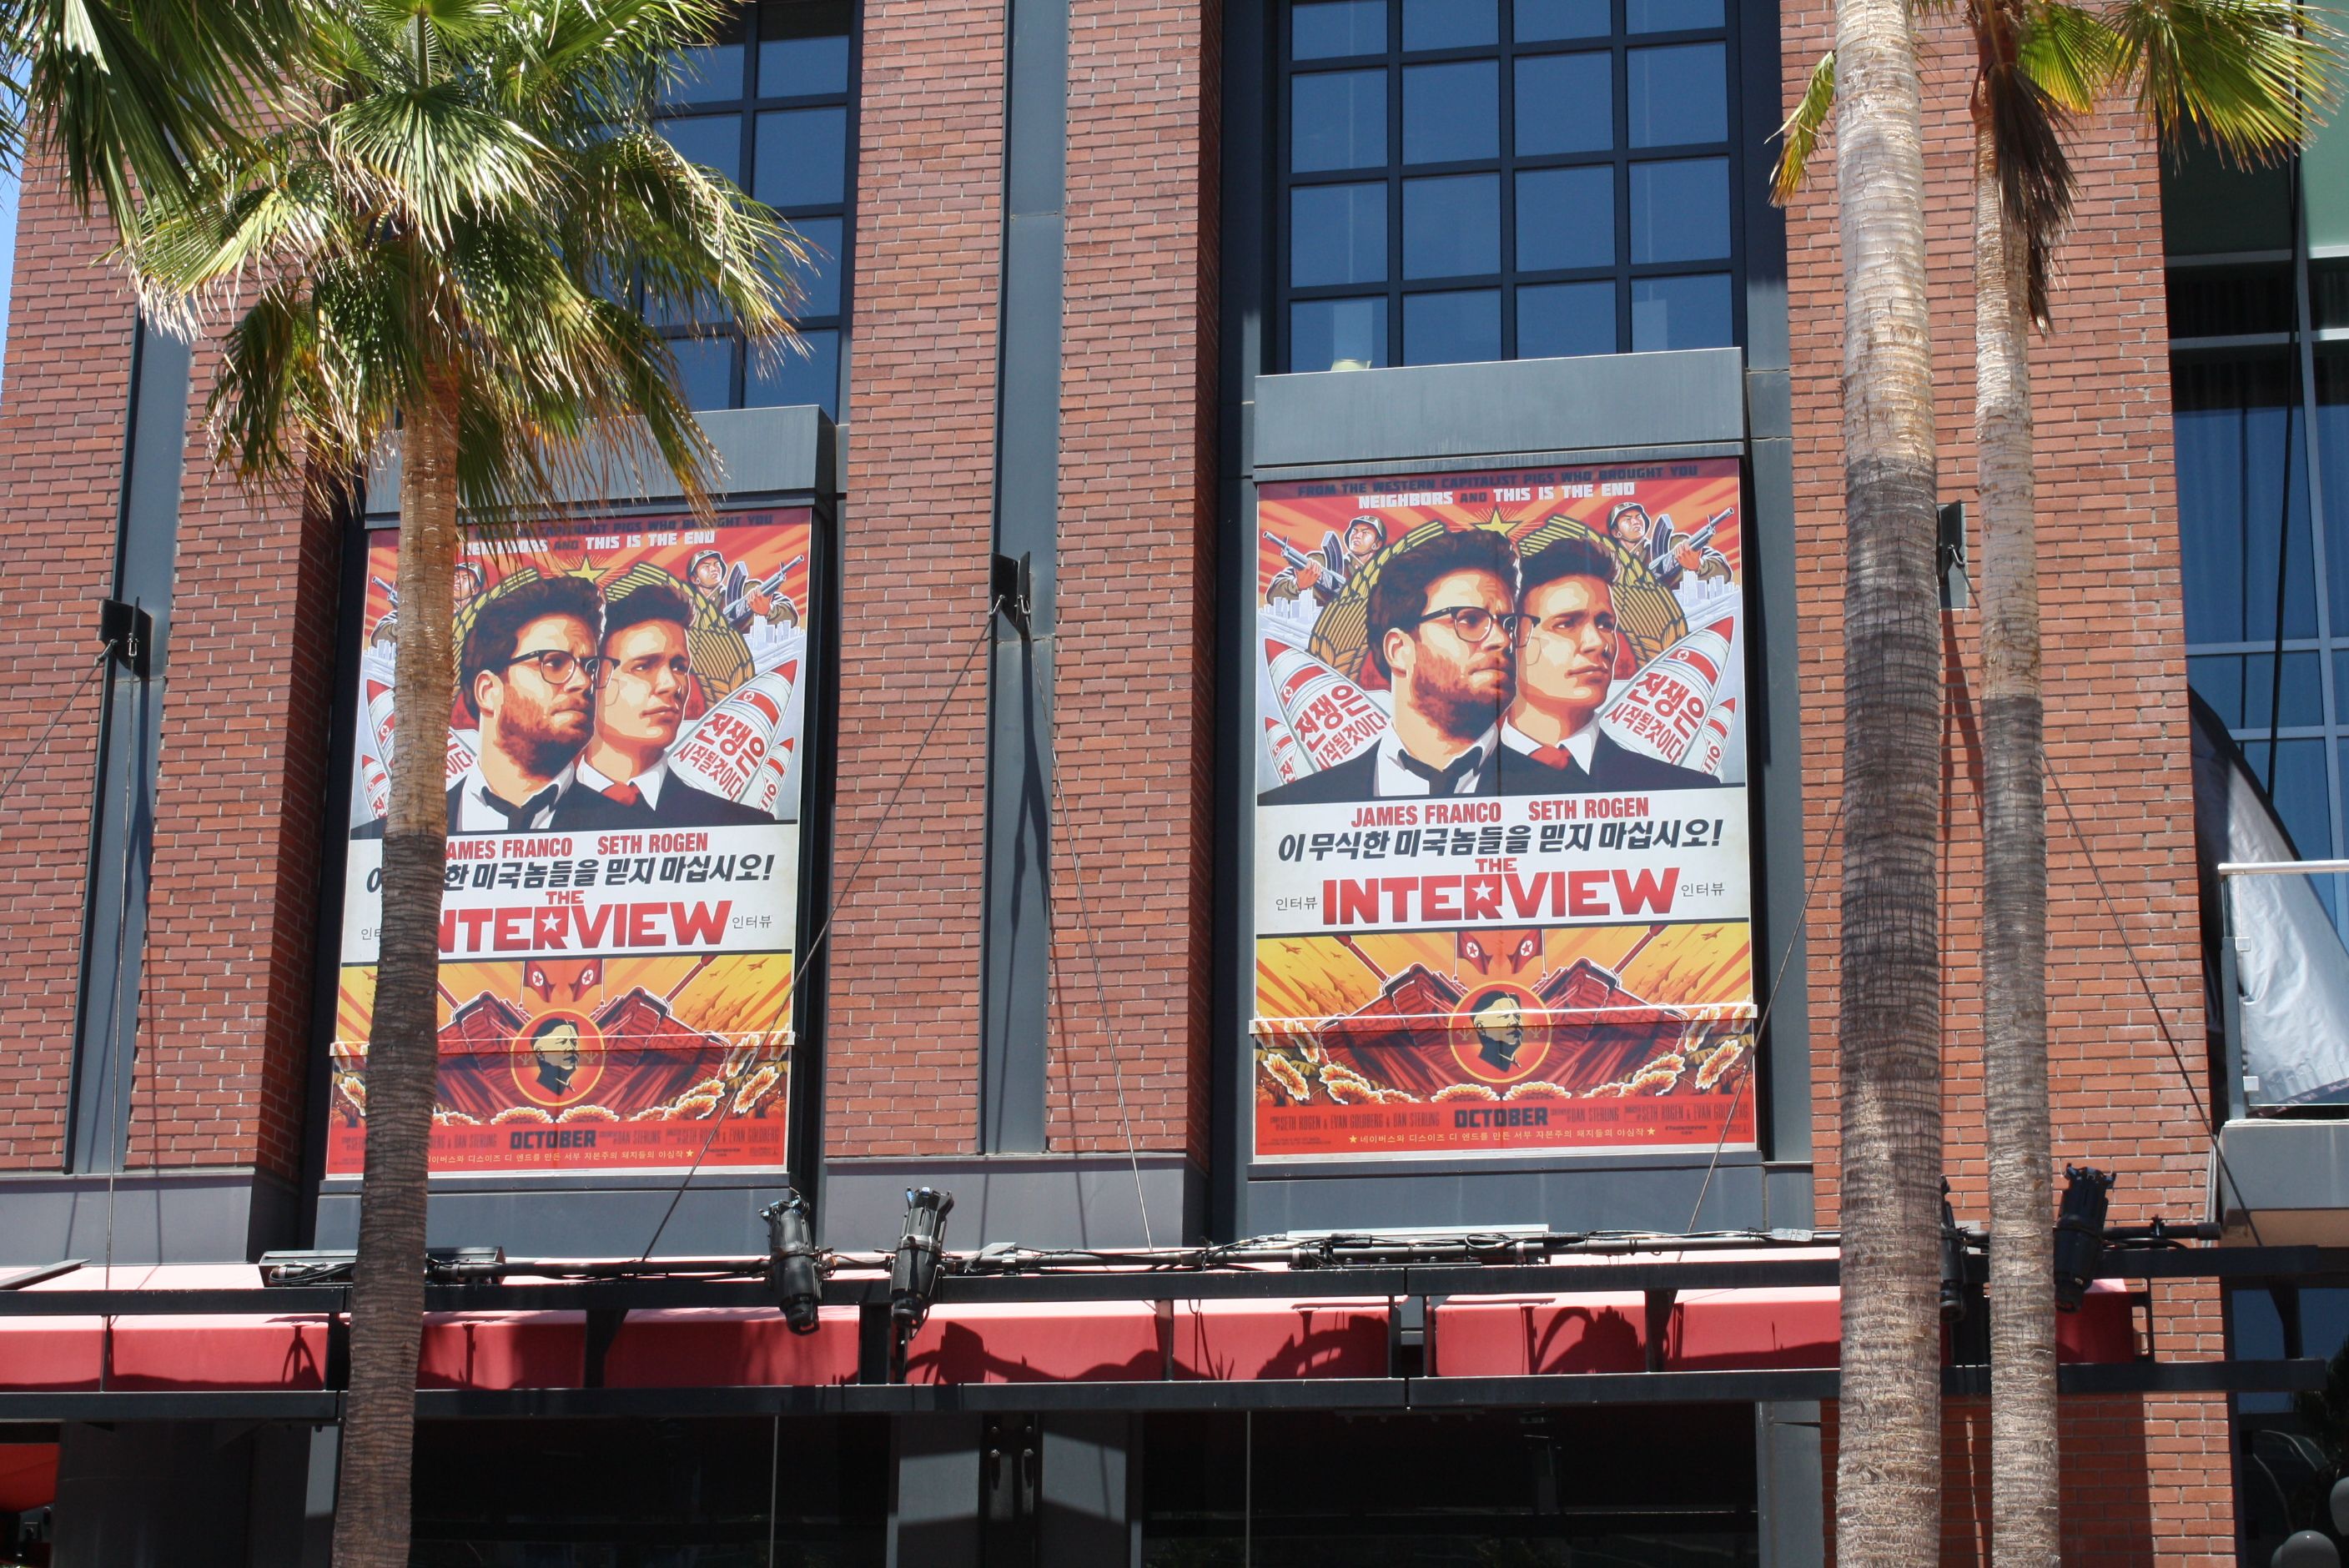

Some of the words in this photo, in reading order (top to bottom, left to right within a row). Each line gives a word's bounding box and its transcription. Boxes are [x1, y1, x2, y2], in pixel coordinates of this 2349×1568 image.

[1298, 485, 1335, 497] FROM
[1341, 483, 1367, 494] THE
[1373, 480, 1435, 492] WESTERN
[1441, 474, 1517, 489] CAPITALIST
[1524, 473, 1554, 485] PIGS
[1562, 471, 1592, 482] WHO
[1598, 467, 1662, 480] BROUGHT
[1670, 465, 1698, 476] YOU
[1359, 491, 1453, 510] NEIGHBORS
[1461, 492, 1487, 503] AND
[1493, 487, 1531, 502] THIS
[1539, 486, 1554, 500] IS
[1562, 484, 1593, 499] THE
[1601, 482, 1635, 497] END
[614, 521, 641, 533] PIGS
[648, 520, 677, 531] WHO
[682, 515, 741, 530] BRGHT
[747, 514, 773, 525] YOU
[586, 535, 620, 550] THIS
[626, 534, 641, 549] IS
[648, 532, 677, 547] THE
[684, 530, 715, 545] END
[1627, 671, 1704, 741] 전쟁은
[1295, 685, 1371, 753] 전쟁은
[694, 712, 765, 779] 전쟁은
[1351, 805, 1418, 827] JAMES
[1425, 802, 1501, 825] FRANCO
[1528, 800, 1577, 821] SETH
[1585, 797, 1648, 819] ROGEN
[445, 840, 496, 861] AMES
[502, 837, 573, 858] FRANCO
[597, 835, 642, 855] SETH
[649, 832, 708, 853] ROGEN
[1394, 825, 1532, 857] 미국놈들을
[1539, 822, 1593, 853] 믿지
[1597, 818, 1723, 850] 마십시오!
[471, 858, 599, 890] 미국놈들을
[605, 857, 656, 887] 믿지
[659, 853, 775, 883] 마십시오!
[1475, 857, 1517, 872] THE
[546, 890, 585, 905] THE
[1323, 867, 1680, 925] INTERVIEW
[1681, 882, 1725, 897] 인터뷰
[1275, 896, 1318, 912] 인터뷰
[438, 900, 732, 953] NTERVIEW
[732, 914, 772, 929] 인터뷰
[1454, 1106, 1547, 1129] OCTOBER
[510, 1129, 596, 1150] OCTOBER
[1360, 1133, 1405, 1143] 네이버스와
[1409, 1133, 1445, 1142] 디스이즈
[1449, 1133, 1457, 1141] 디
[468, 1154, 500, 1163] 디스이즈
